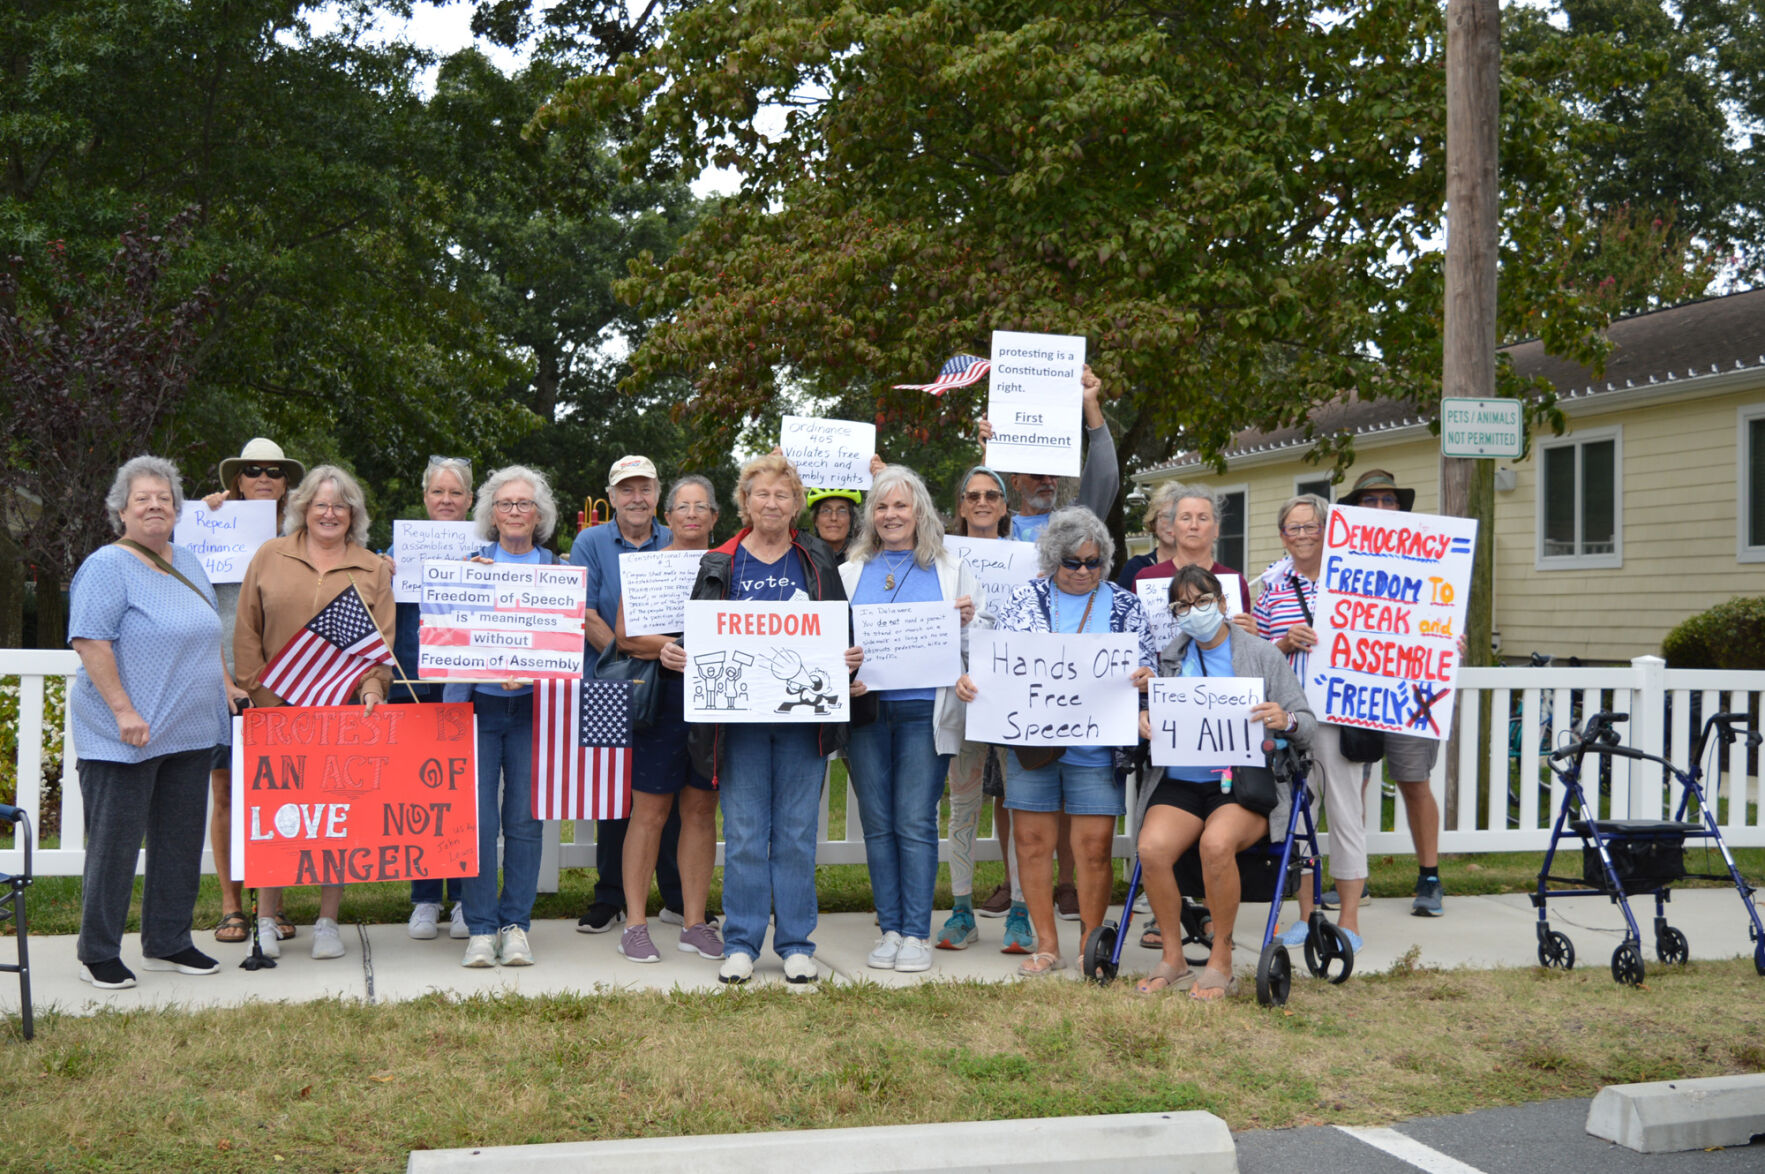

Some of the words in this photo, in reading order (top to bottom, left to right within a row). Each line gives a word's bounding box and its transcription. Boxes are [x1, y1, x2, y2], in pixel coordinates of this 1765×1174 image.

[999, 348, 1054, 361] protesting
[1056, 350, 1065, 359] is
[998, 364, 1074, 378] Constitutional
[997, 382, 1026, 394] right.
[1015, 412, 1043, 424] First
[789, 422, 852, 436] Ordinance
[810, 435, 833, 444] 405
[991, 431, 1071, 446] Amendment
[1448, 432, 1467, 445] NOT
[1468, 432, 1516, 446] PERMITTED
[786, 446, 830, 458] Violates
[834, 461, 852, 470] and
[830, 473, 863, 486] rights
[194, 510, 237, 534] Repeal
[402, 523, 466, 544] Regulating
[402, 542, 453, 551] assemblies
[206, 557, 233, 573] 405
[959, 546, 1014, 572] Repeal
[428, 568, 455, 581] Our
[466, 569, 533, 583] Founders
[539, 571, 579, 585] Knew
[1325, 556, 1423, 602] FREEDOM
[1428, 576, 1454, 603] TO
[427, 589, 490, 602] Freedom
[500, 592, 514, 604] of
[522, 592, 575, 607] Speech
[456, 611, 468, 623] is
[479, 612, 557, 627] meaningless
[717, 612, 821, 636] FREEDOM
[1330, 599, 1411, 635] SPEAK
[1419, 616, 1453, 637] and
[474, 632, 529, 646] without
[421, 653, 485, 667] Freedom
[489, 655, 504, 667] of
[510, 655, 580, 672] Assembly
[993, 642, 1077, 680] Hands
[1093, 648, 1133, 678] Off
[1330, 632, 1453, 681] ASSEMBLE
[1030, 684, 1082, 708] Free
[1153, 683, 1187, 703] Free
[1194, 684, 1259, 709] Speech
[243, 711, 404, 746] PROTEST
[435, 707, 467, 741] IS
[1002, 711, 1099, 741] Speech
[1162, 719, 1176, 749] 4
[252, 755, 307, 790] AN
[320, 755, 389, 789] ACT
[419, 758, 467, 790] OF
[250, 803, 350, 841] LOVE
[382, 803, 452, 836] NOT
[295, 845, 429, 885] ANGER
